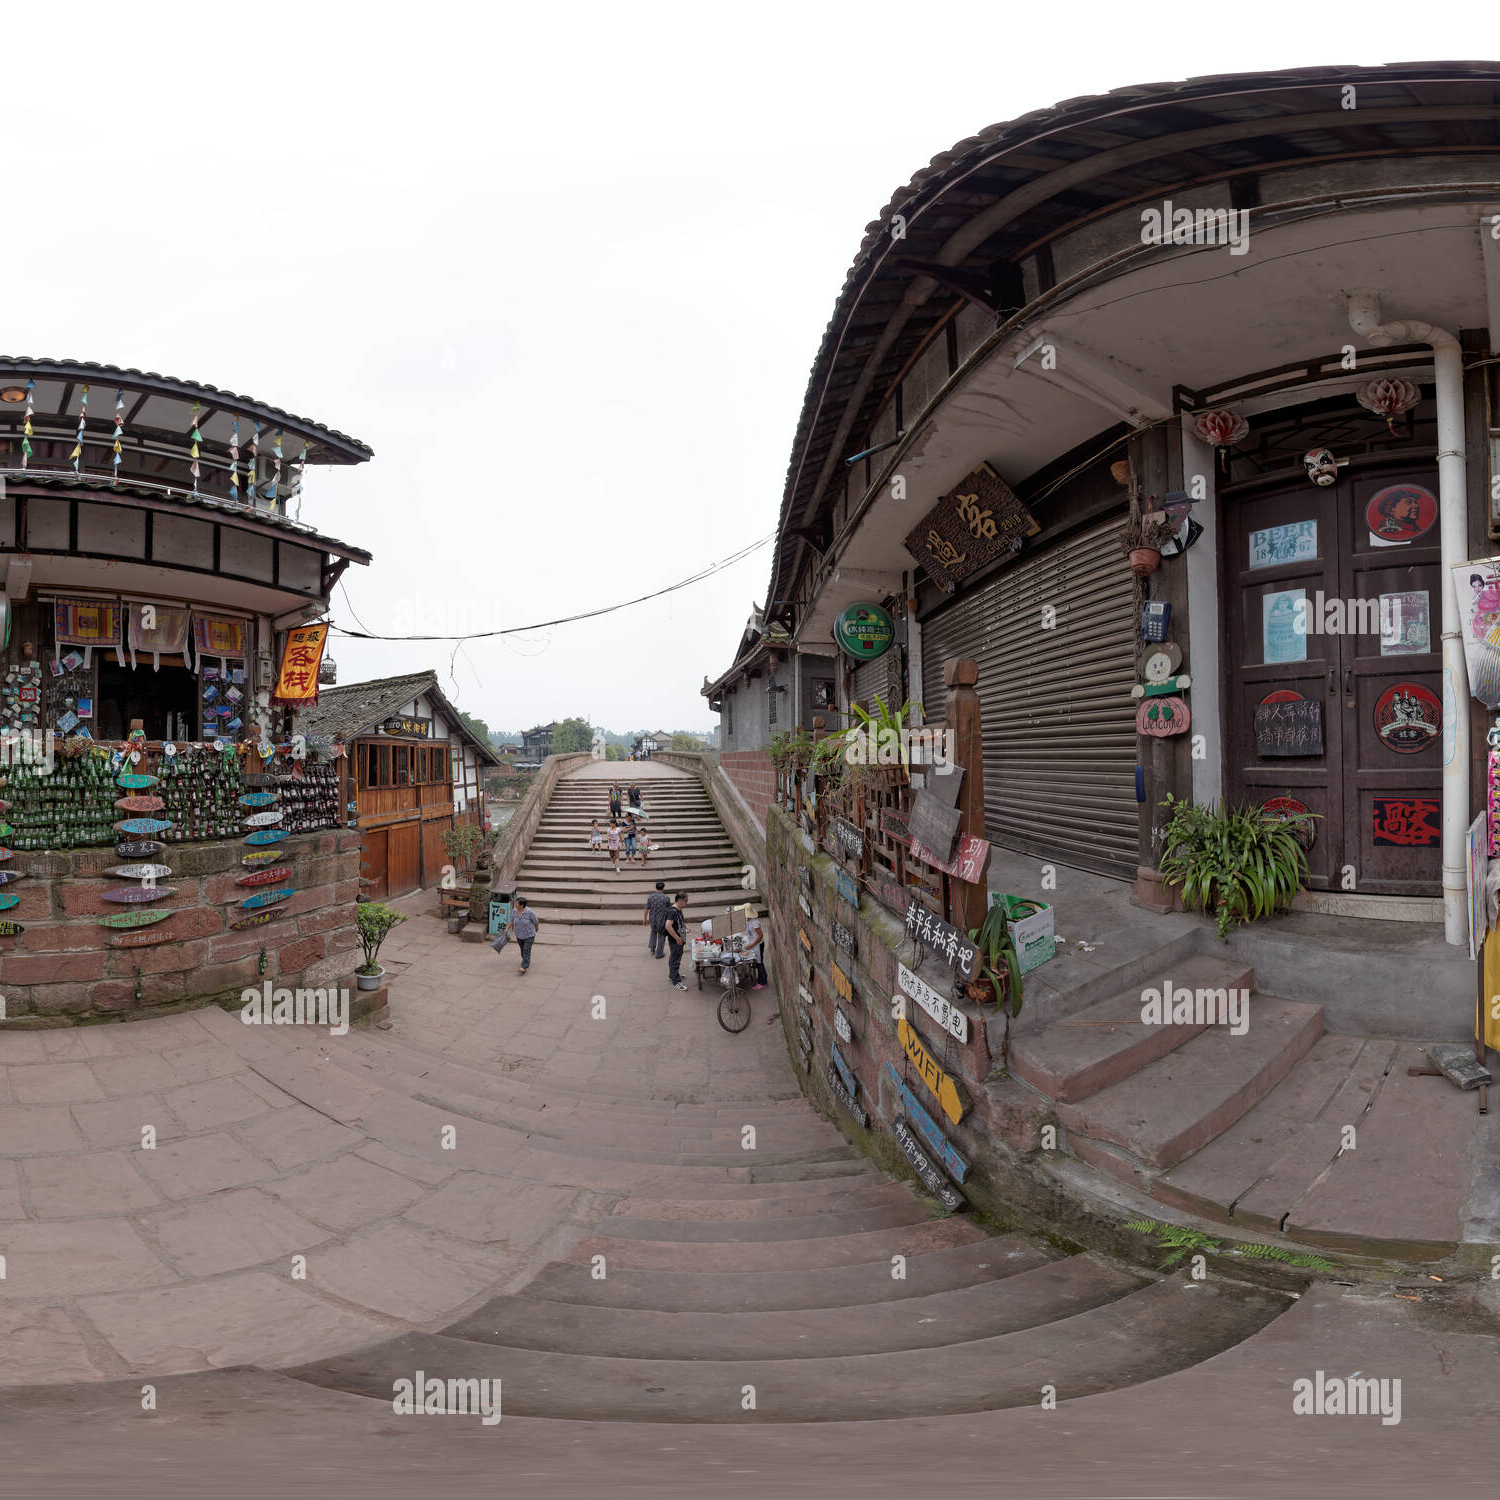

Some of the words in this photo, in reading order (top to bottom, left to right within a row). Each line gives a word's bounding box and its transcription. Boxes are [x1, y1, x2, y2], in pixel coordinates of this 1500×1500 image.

[986, 534, 1013, 554] Guest
[1253, 520, 1316, 548] BEER
[905, 901, 973, 974] 来平乐私奔吧
[906, 1024, 941, 1093] WIFI
